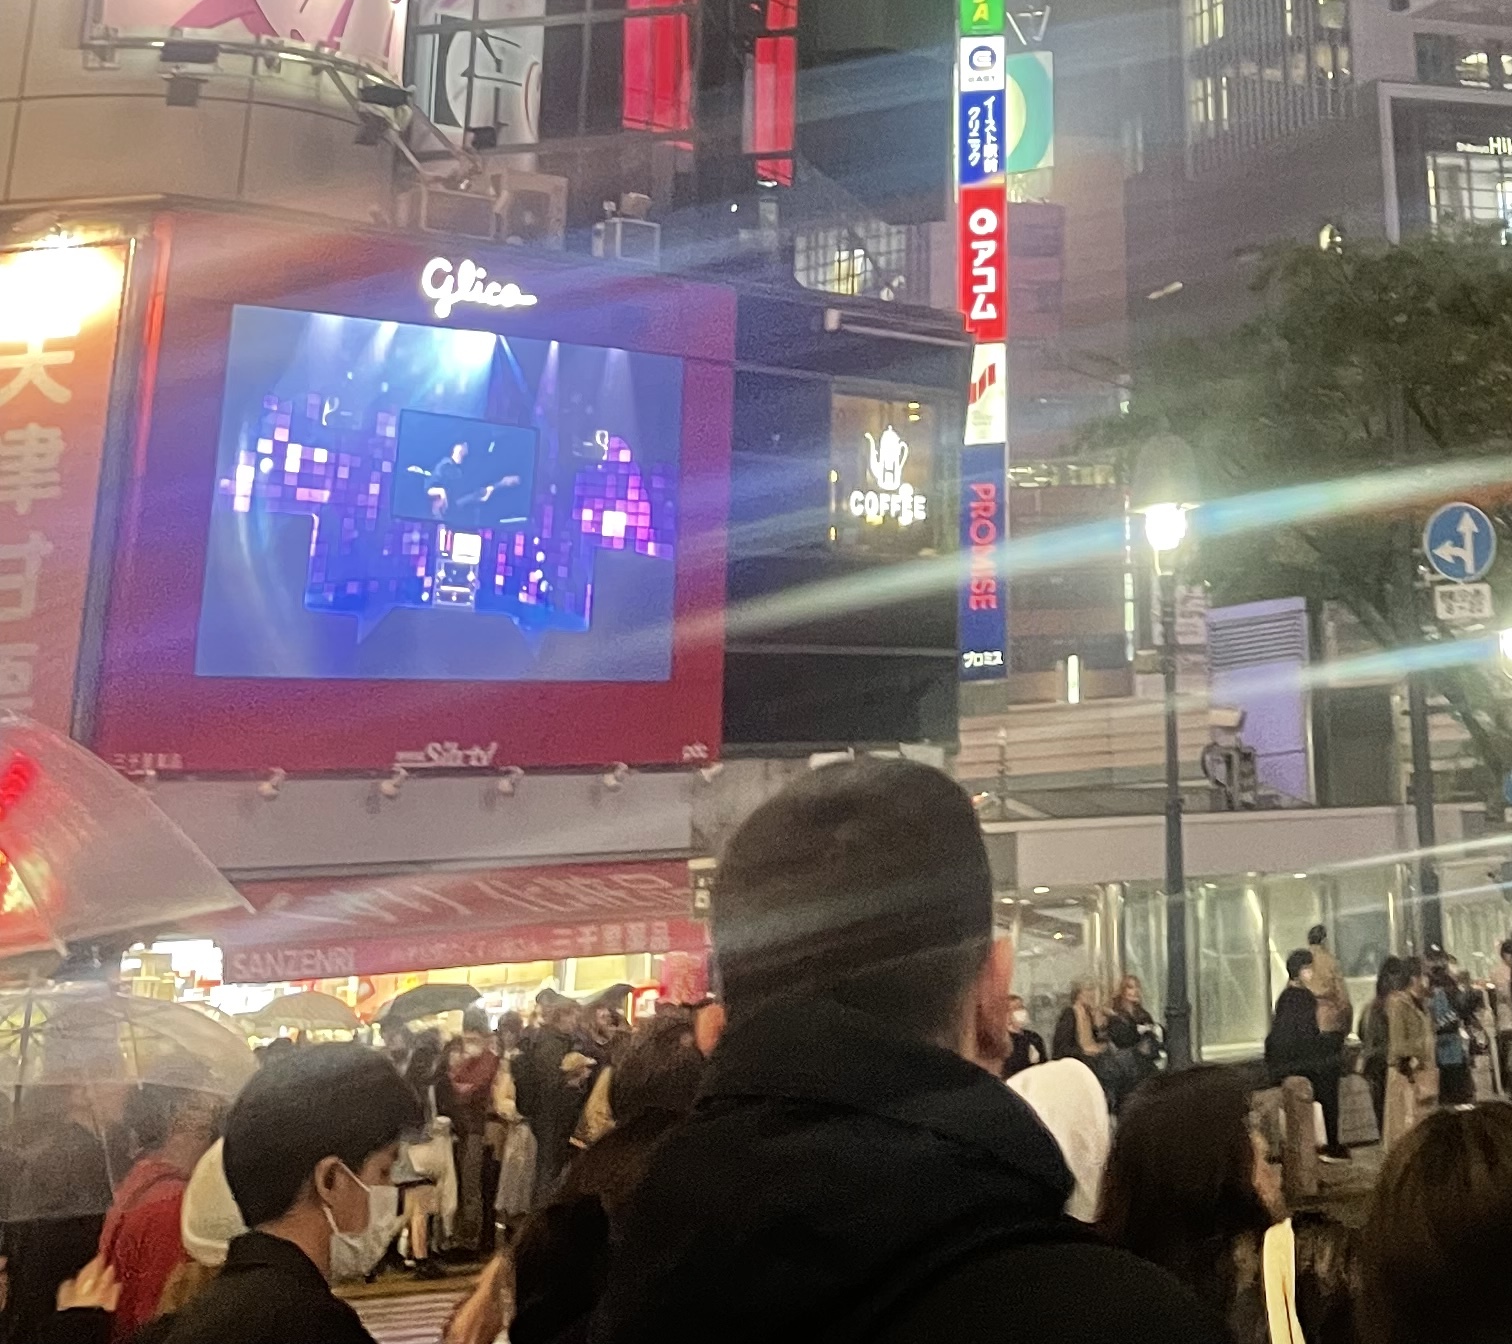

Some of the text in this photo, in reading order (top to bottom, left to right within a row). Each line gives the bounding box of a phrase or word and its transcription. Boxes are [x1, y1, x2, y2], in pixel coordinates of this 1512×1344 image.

[421, 256, 538, 319] Glico
[970, 240, 998, 320] アコム
[849, 490, 927, 521] COFFEE
